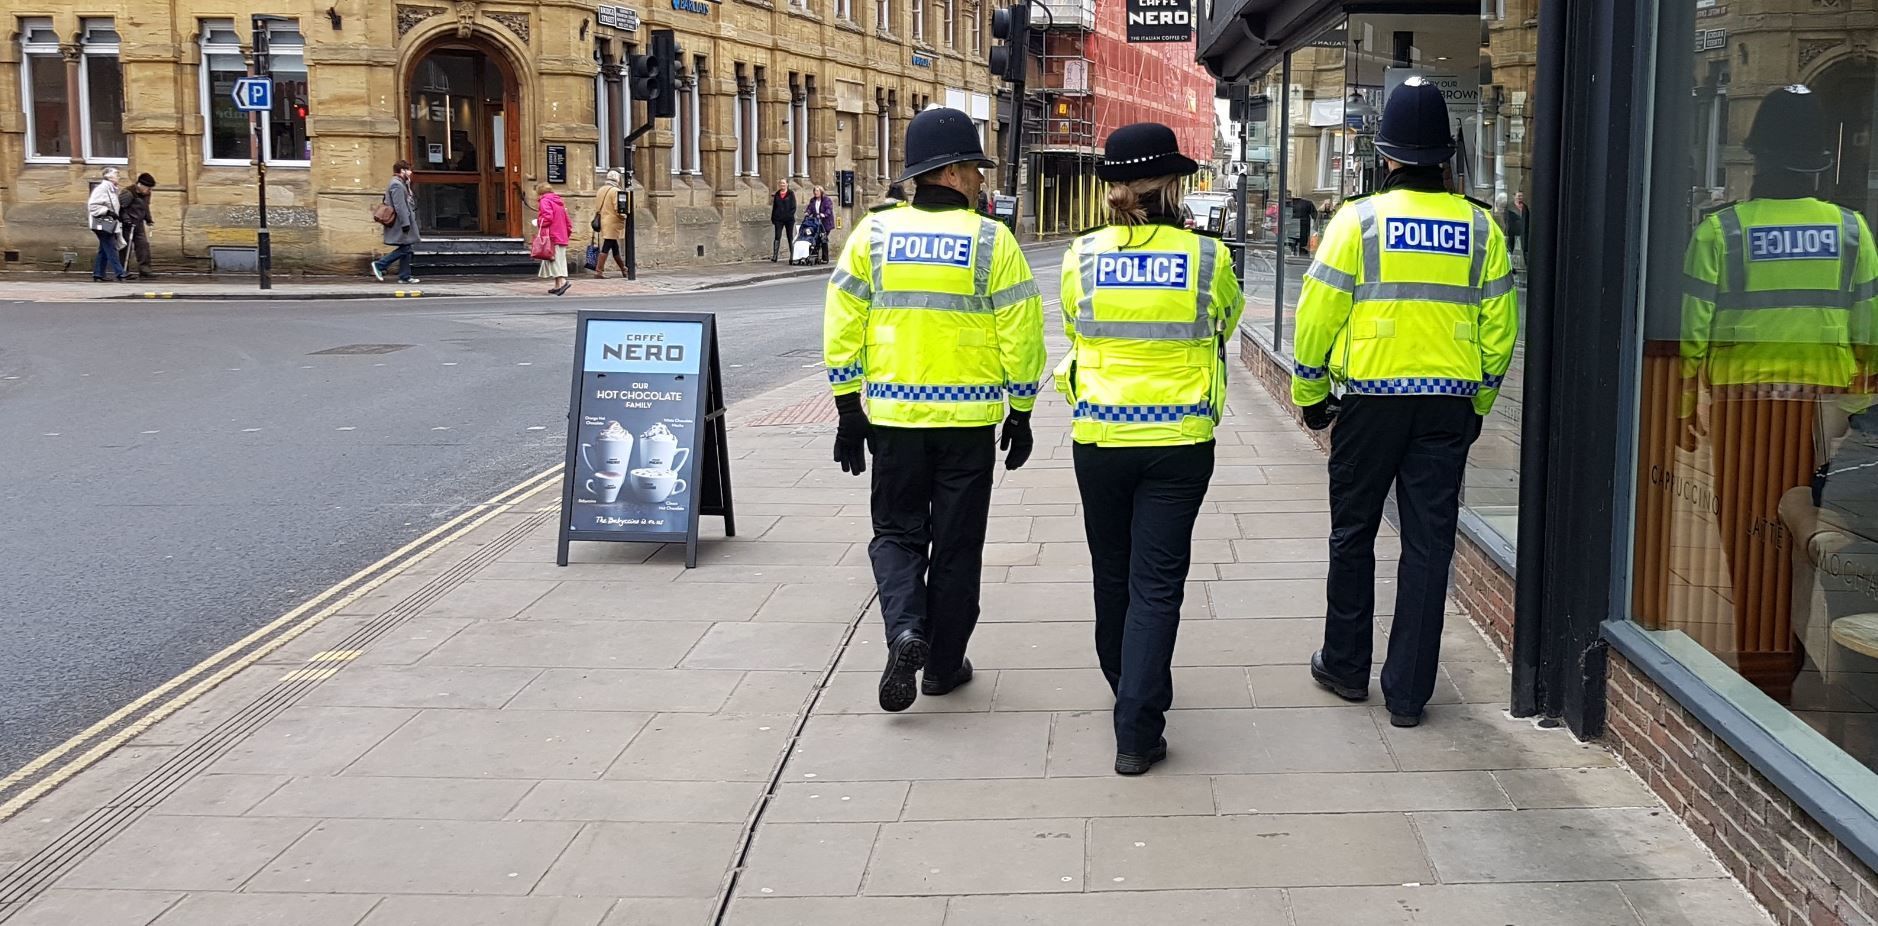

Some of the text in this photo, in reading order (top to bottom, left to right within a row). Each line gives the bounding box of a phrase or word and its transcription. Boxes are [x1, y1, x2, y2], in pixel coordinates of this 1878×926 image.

[1129, 11, 1189, 25] NERO
[252, 86, 264, 103] P
[1389, 221, 1466, 250] POLICE
[890, 235, 969, 262] POLICE
[1099, 256, 1186, 283] POLICE
[602, 343, 684, 362] NERO
[597, 390, 682, 401] HOT CHOCOLATE
[1651, 465, 1720, 516] CAPPUCCINO
[595, 516, 607, 524] The
